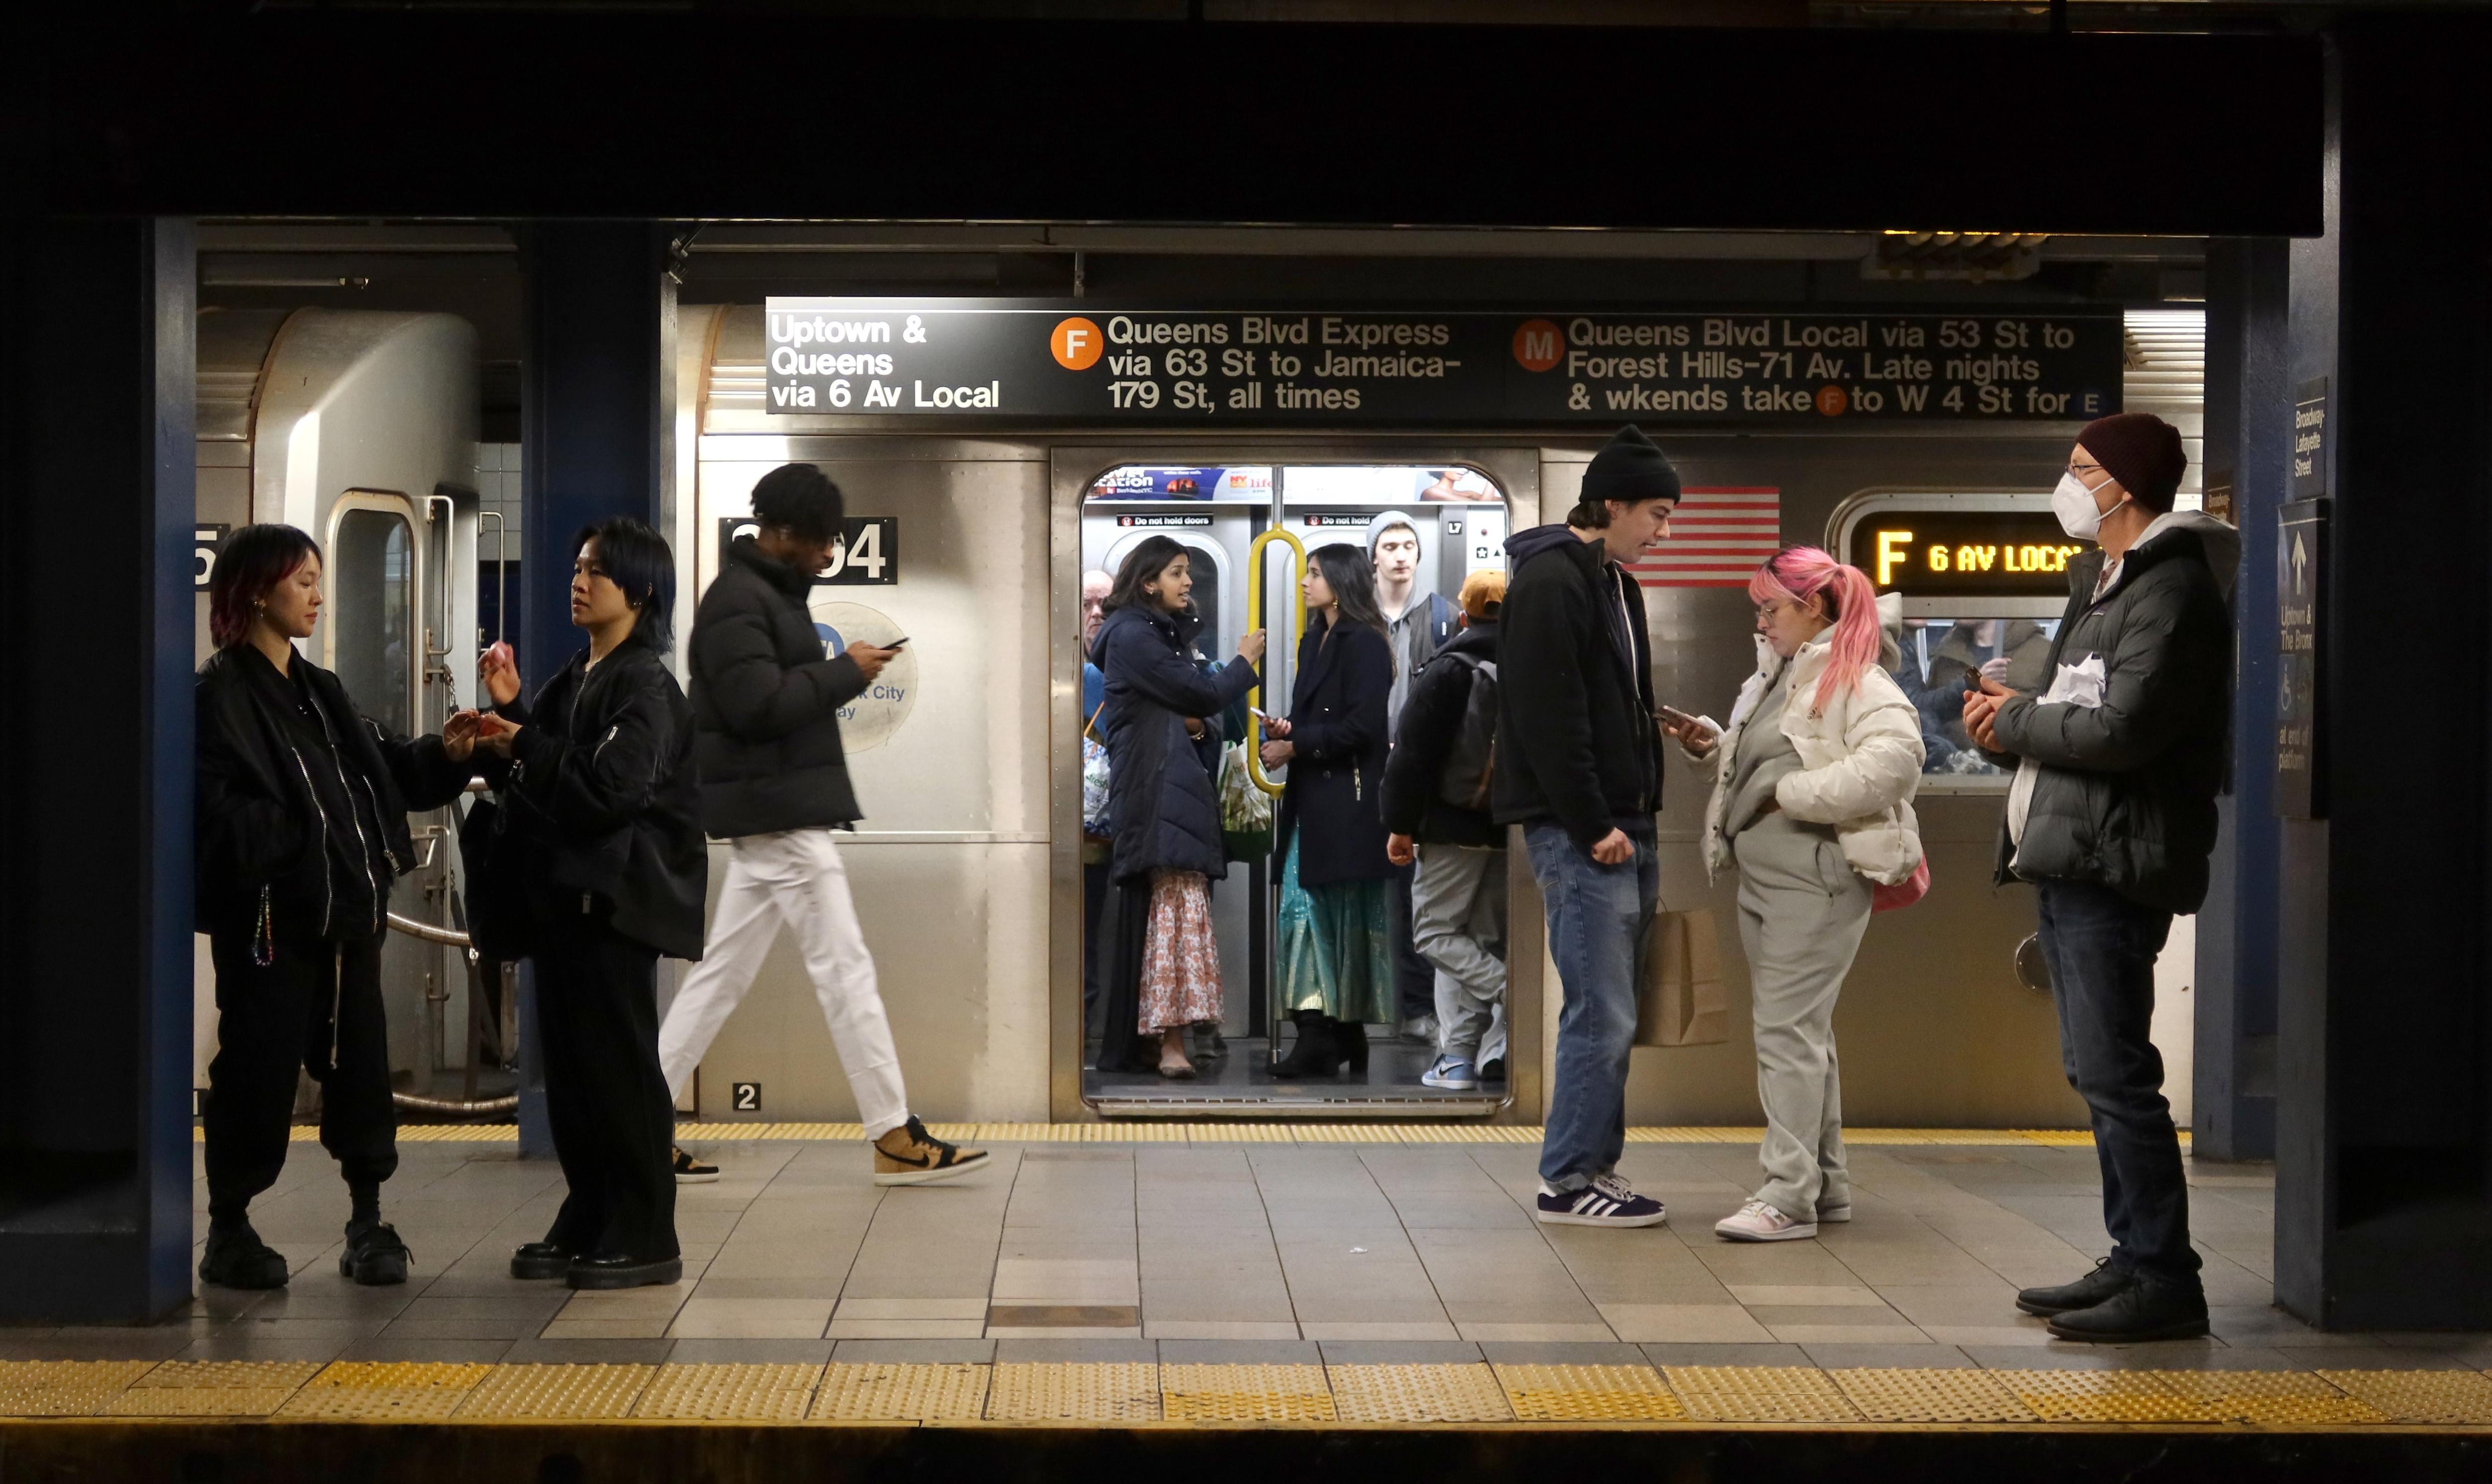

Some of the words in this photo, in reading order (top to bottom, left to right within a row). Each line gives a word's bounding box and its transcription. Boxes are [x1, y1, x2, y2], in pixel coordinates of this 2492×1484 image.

[771, 315, 890, 347] Uptown
[903, 315, 927, 343] &
[1067, 330, 1088, 358] F
[1108, 316, 1229, 344] Queens
[1243, 317, 1308, 344] Blvd
[1322, 318, 1449, 349] Express
[1568, 318, 1690, 347] Queens
[1704, 319, 1770, 347] Blvd
[1783, 320, 1868, 347] Local
[1881, 320, 1924, 347] via
[1939, 320, 1981, 348] 53
[1995, 320, 2029, 348] St
[2043, 323, 2074, 348] to
[1525, 331, 1554, 360] M
[772, 346, 893, 375] Queens
[1107, 349, 1151, 376] via
[1165, 349, 1208, 377] 63
[1221, 349, 1255, 377] St
[1269, 351, 1301, 377] to
[1314, 350, 1461, 377] Jamaica-
[1568, 351, 1669, 379] Forest
[1682, 351, 1792, 379] Hills-71
[1806, 352, 1850, 379] Av.
[1865, 353, 1932, 380] Late
[1947, 353, 2039, 386] nights
[772, 380, 816, 407] via
[829, 379, 851, 408] 6
[863, 380, 902, 407] Av
[915, 380, 999, 408] Local
[1107, 381, 1160, 409] 179
[1173, 381, 1215, 414] St,
[1229, 382, 1261, 409] all
[1275, 382, 1361, 409] times
[1568, 383, 1591, 410] &
[1605, 383, 1727, 411] wkends
[1741, 384, 1811, 411] take
[1824, 392, 1839, 411] F
[1852, 386, 1883, 412] to
[1896, 385, 1929, 412] W
[1942, 386, 1964, 412] 4
[1977, 386, 2013, 413] St
[2026, 386, 2071, 413] for
[2085, 394, 2099, 413] E
[2296, 408, 2325, 429] Broadway-
[2295, 432, 2321, 455] Lafayette
[2295, 457, 2312, 477] Street
[1164, 516, 1183, 525] hold
[1351, 516, 1370, 525] hold
[1449, 523, 1462, 533] L7
[1878, 531, 1913, 585] F
[1930, 546, 1949, 571] 6
[1957, 546, 1996, 571] AV
[2005, 546, 2081, 571] LOCA
[2281, 605, 2305, 630] Uptown
[2306, 603, 2312, 625] &
[2281, 630, 2293, 650] The
[2295, 629, 2313, 650] Bronx
[873, 686, 905, 702] City
[738, 1084, 755, 1109] 2
